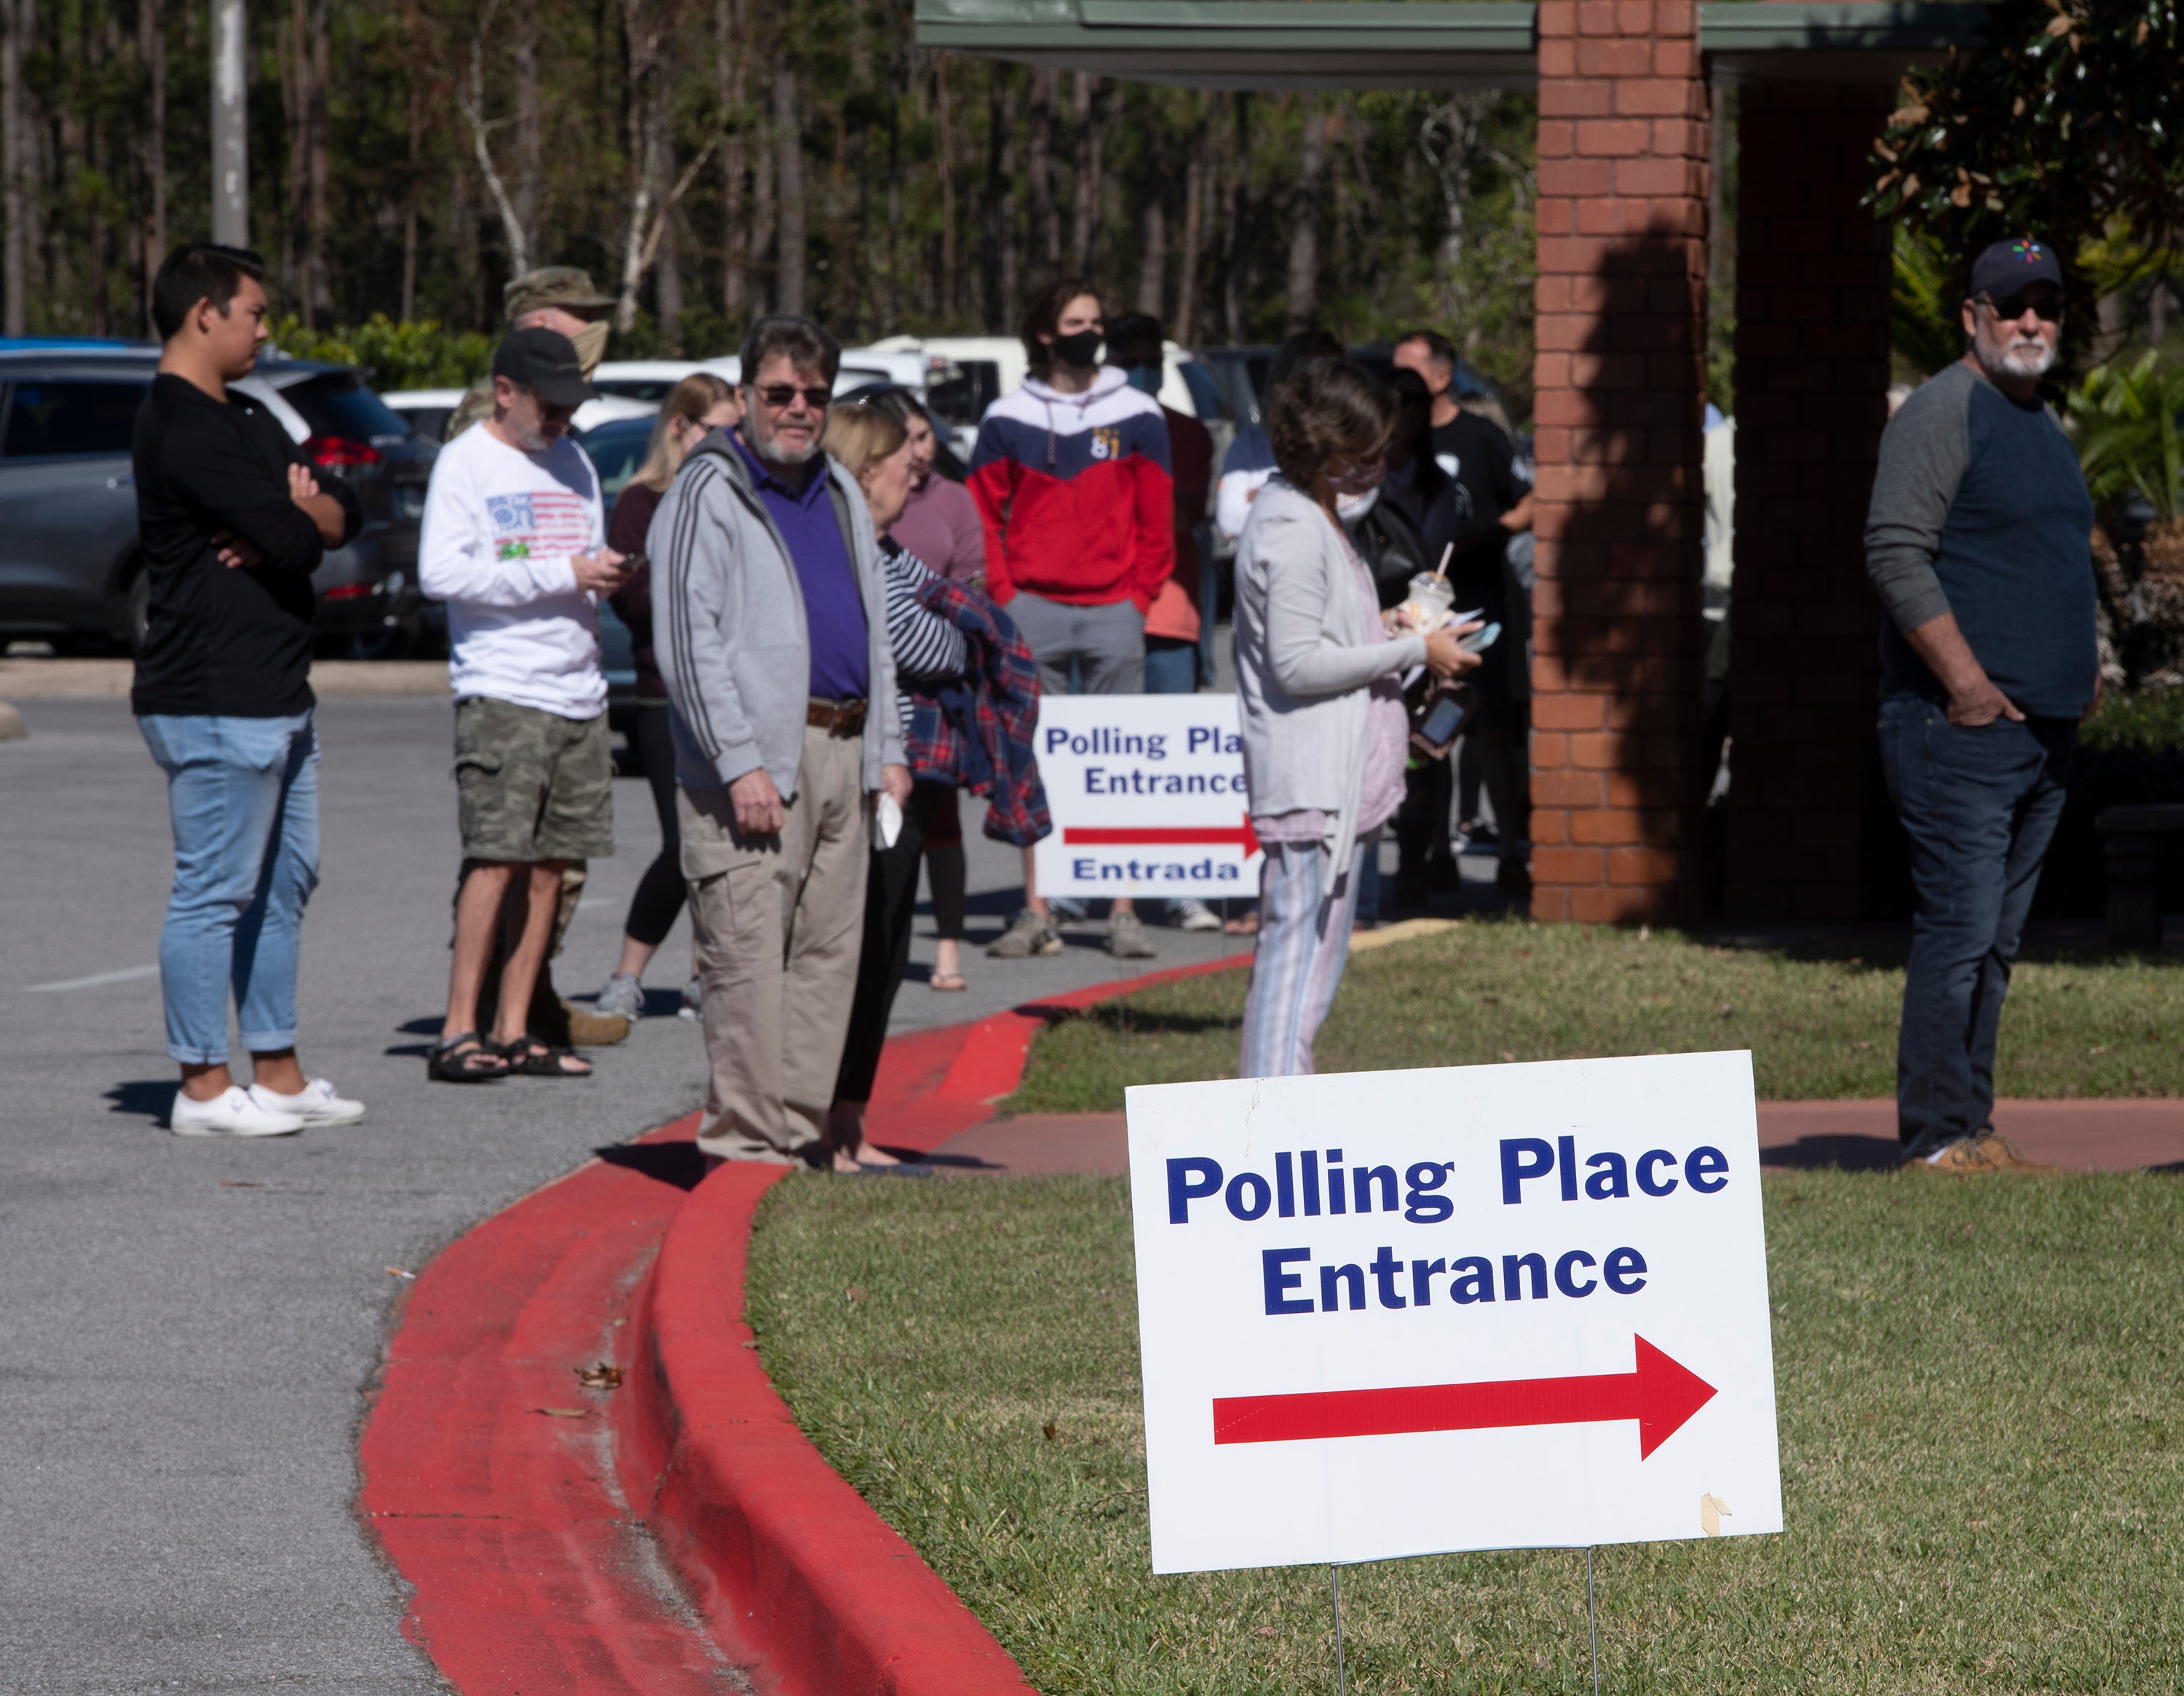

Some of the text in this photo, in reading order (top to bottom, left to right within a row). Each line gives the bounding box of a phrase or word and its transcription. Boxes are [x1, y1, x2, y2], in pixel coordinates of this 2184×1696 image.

[1091, 435, 1120, 460] 81
[1046, 727, 1243, 760] Polling Pla
[1085, 768, 1247, 794] Entrance
[1073, 859, 1240, 880] Entrada
[1166, 1136, 1730, 1225] Polling Place
[1262, 1247, 1647, 1316] Entrance
